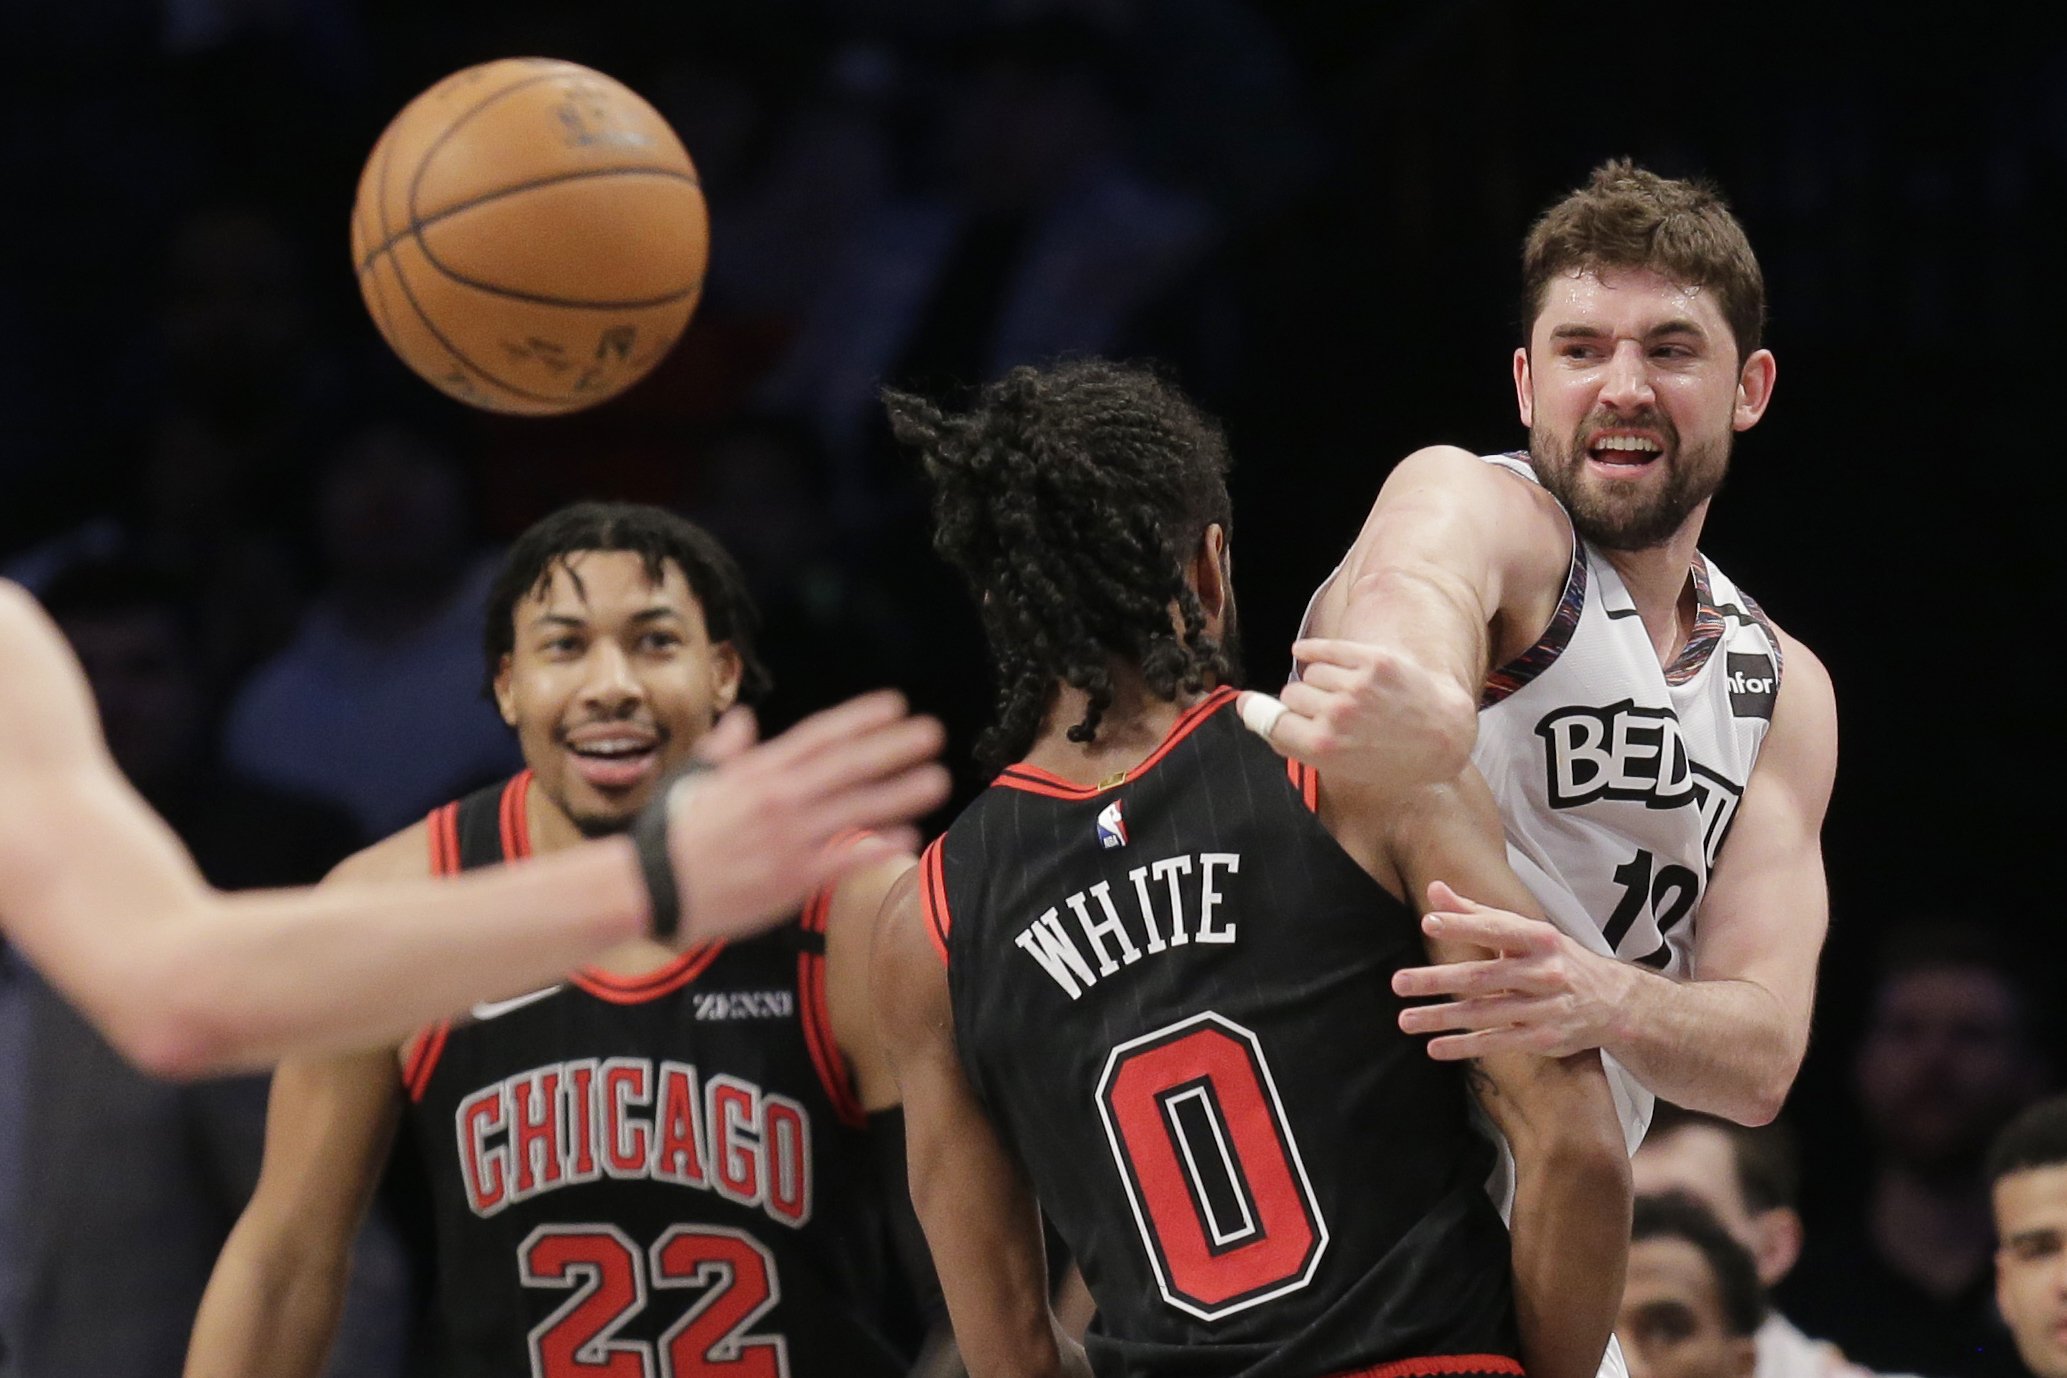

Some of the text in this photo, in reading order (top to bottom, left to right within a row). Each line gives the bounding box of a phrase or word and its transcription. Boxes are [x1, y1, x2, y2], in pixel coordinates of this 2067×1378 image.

[1015, 853, 1240, 1000] WHITE
[456, 1057, 812, 1229] CHICAGO
[1095, 1010, 1330, 1321] 0
[517, 1224, 791, 1378] 22
